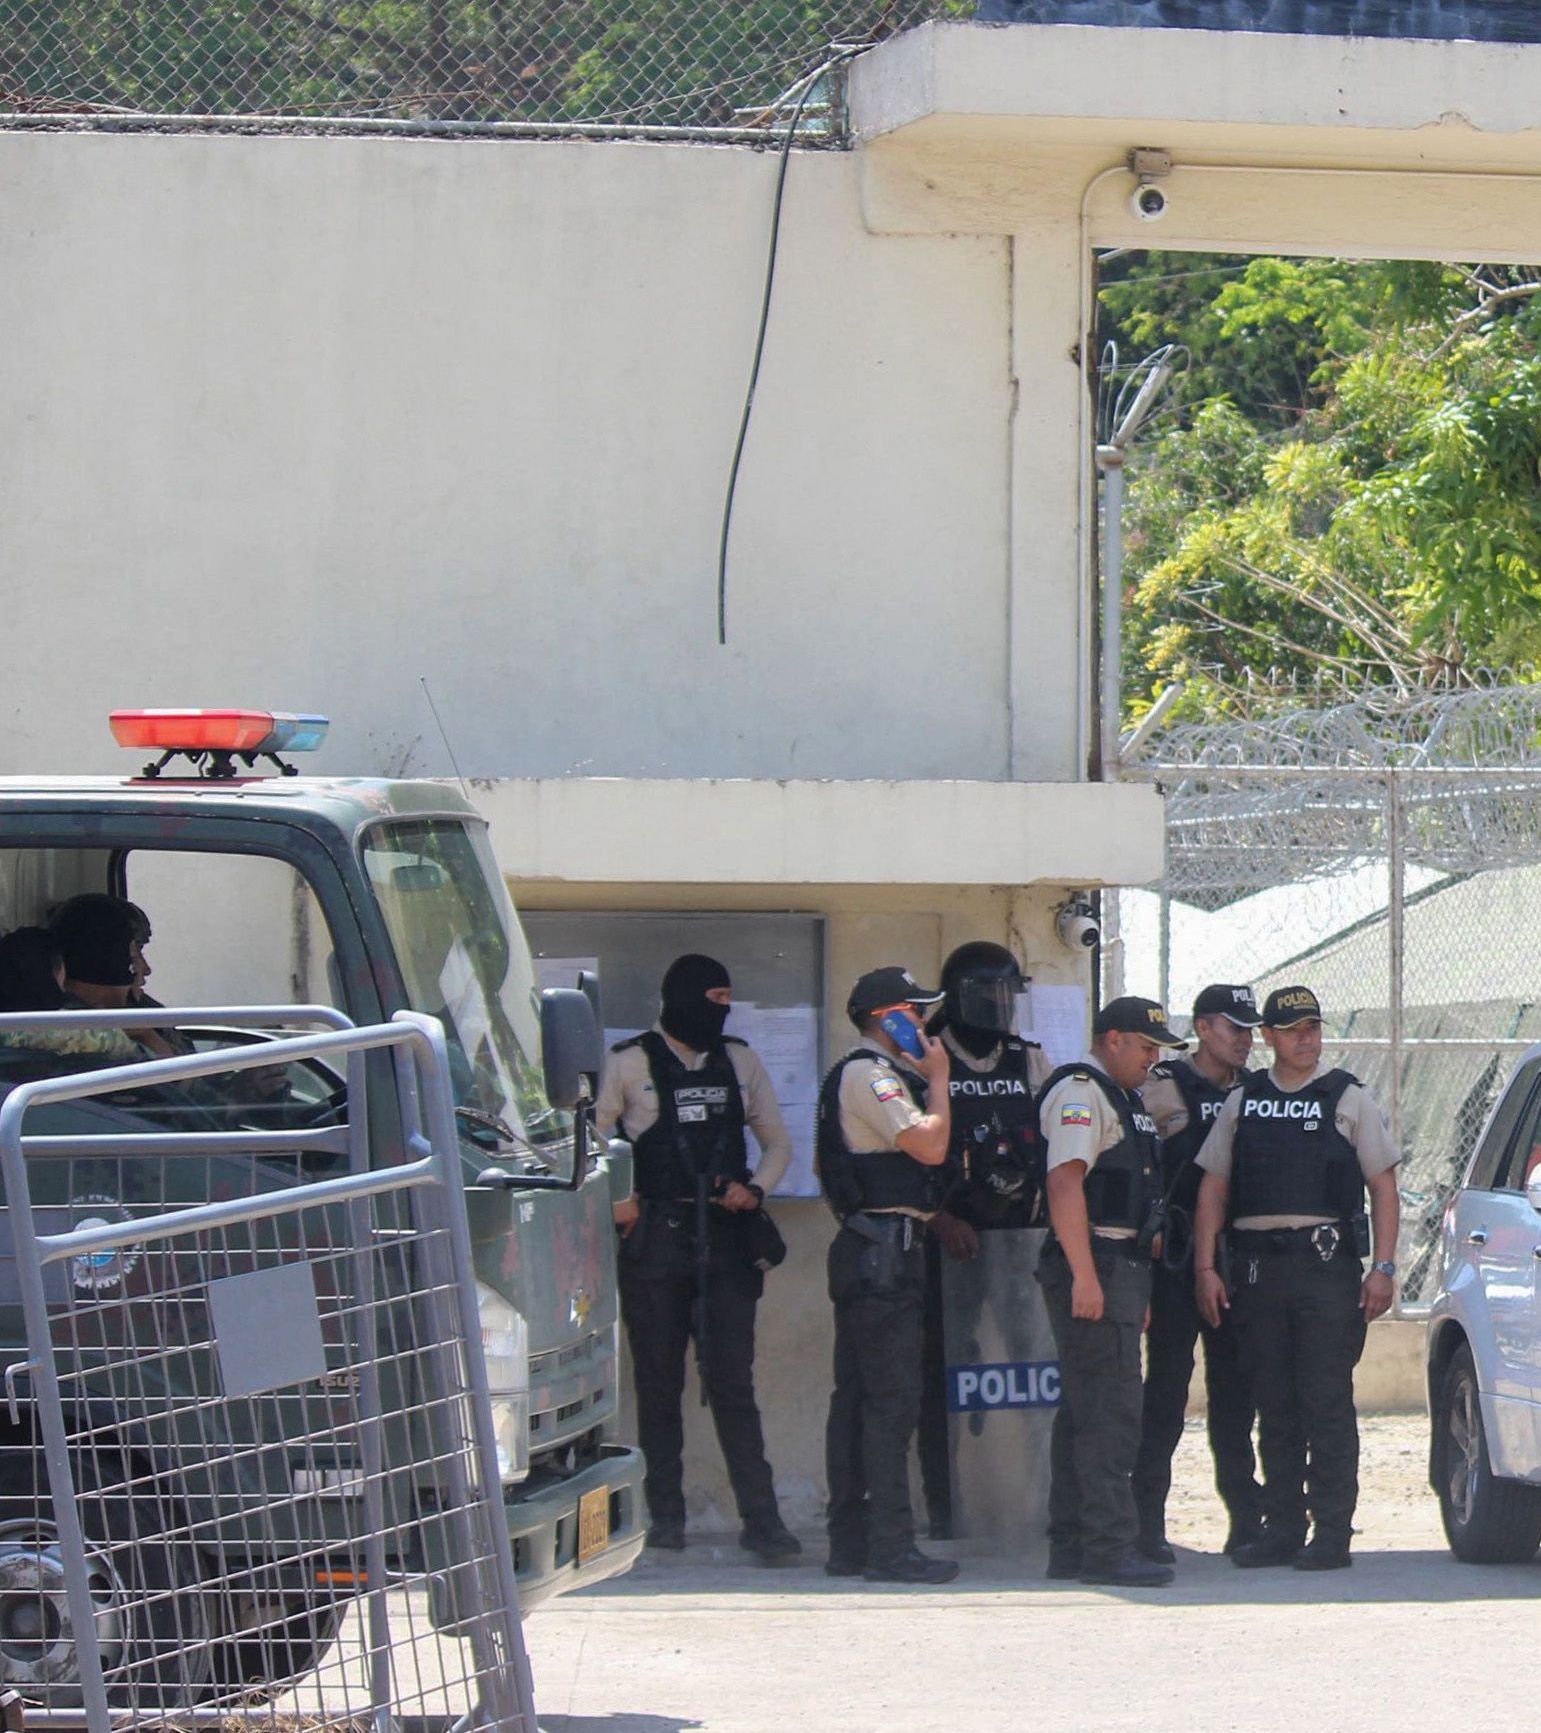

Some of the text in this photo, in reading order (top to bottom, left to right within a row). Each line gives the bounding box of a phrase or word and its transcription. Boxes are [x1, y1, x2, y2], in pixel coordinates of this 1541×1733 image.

[679, 1089, 727, 1100] POLICIA
[950, 1081, 1025, 1097] POLICIA
[1244, 1100, 1322, 1118] POLICIA
[957, 1367, 1060, 1406] POLIC
